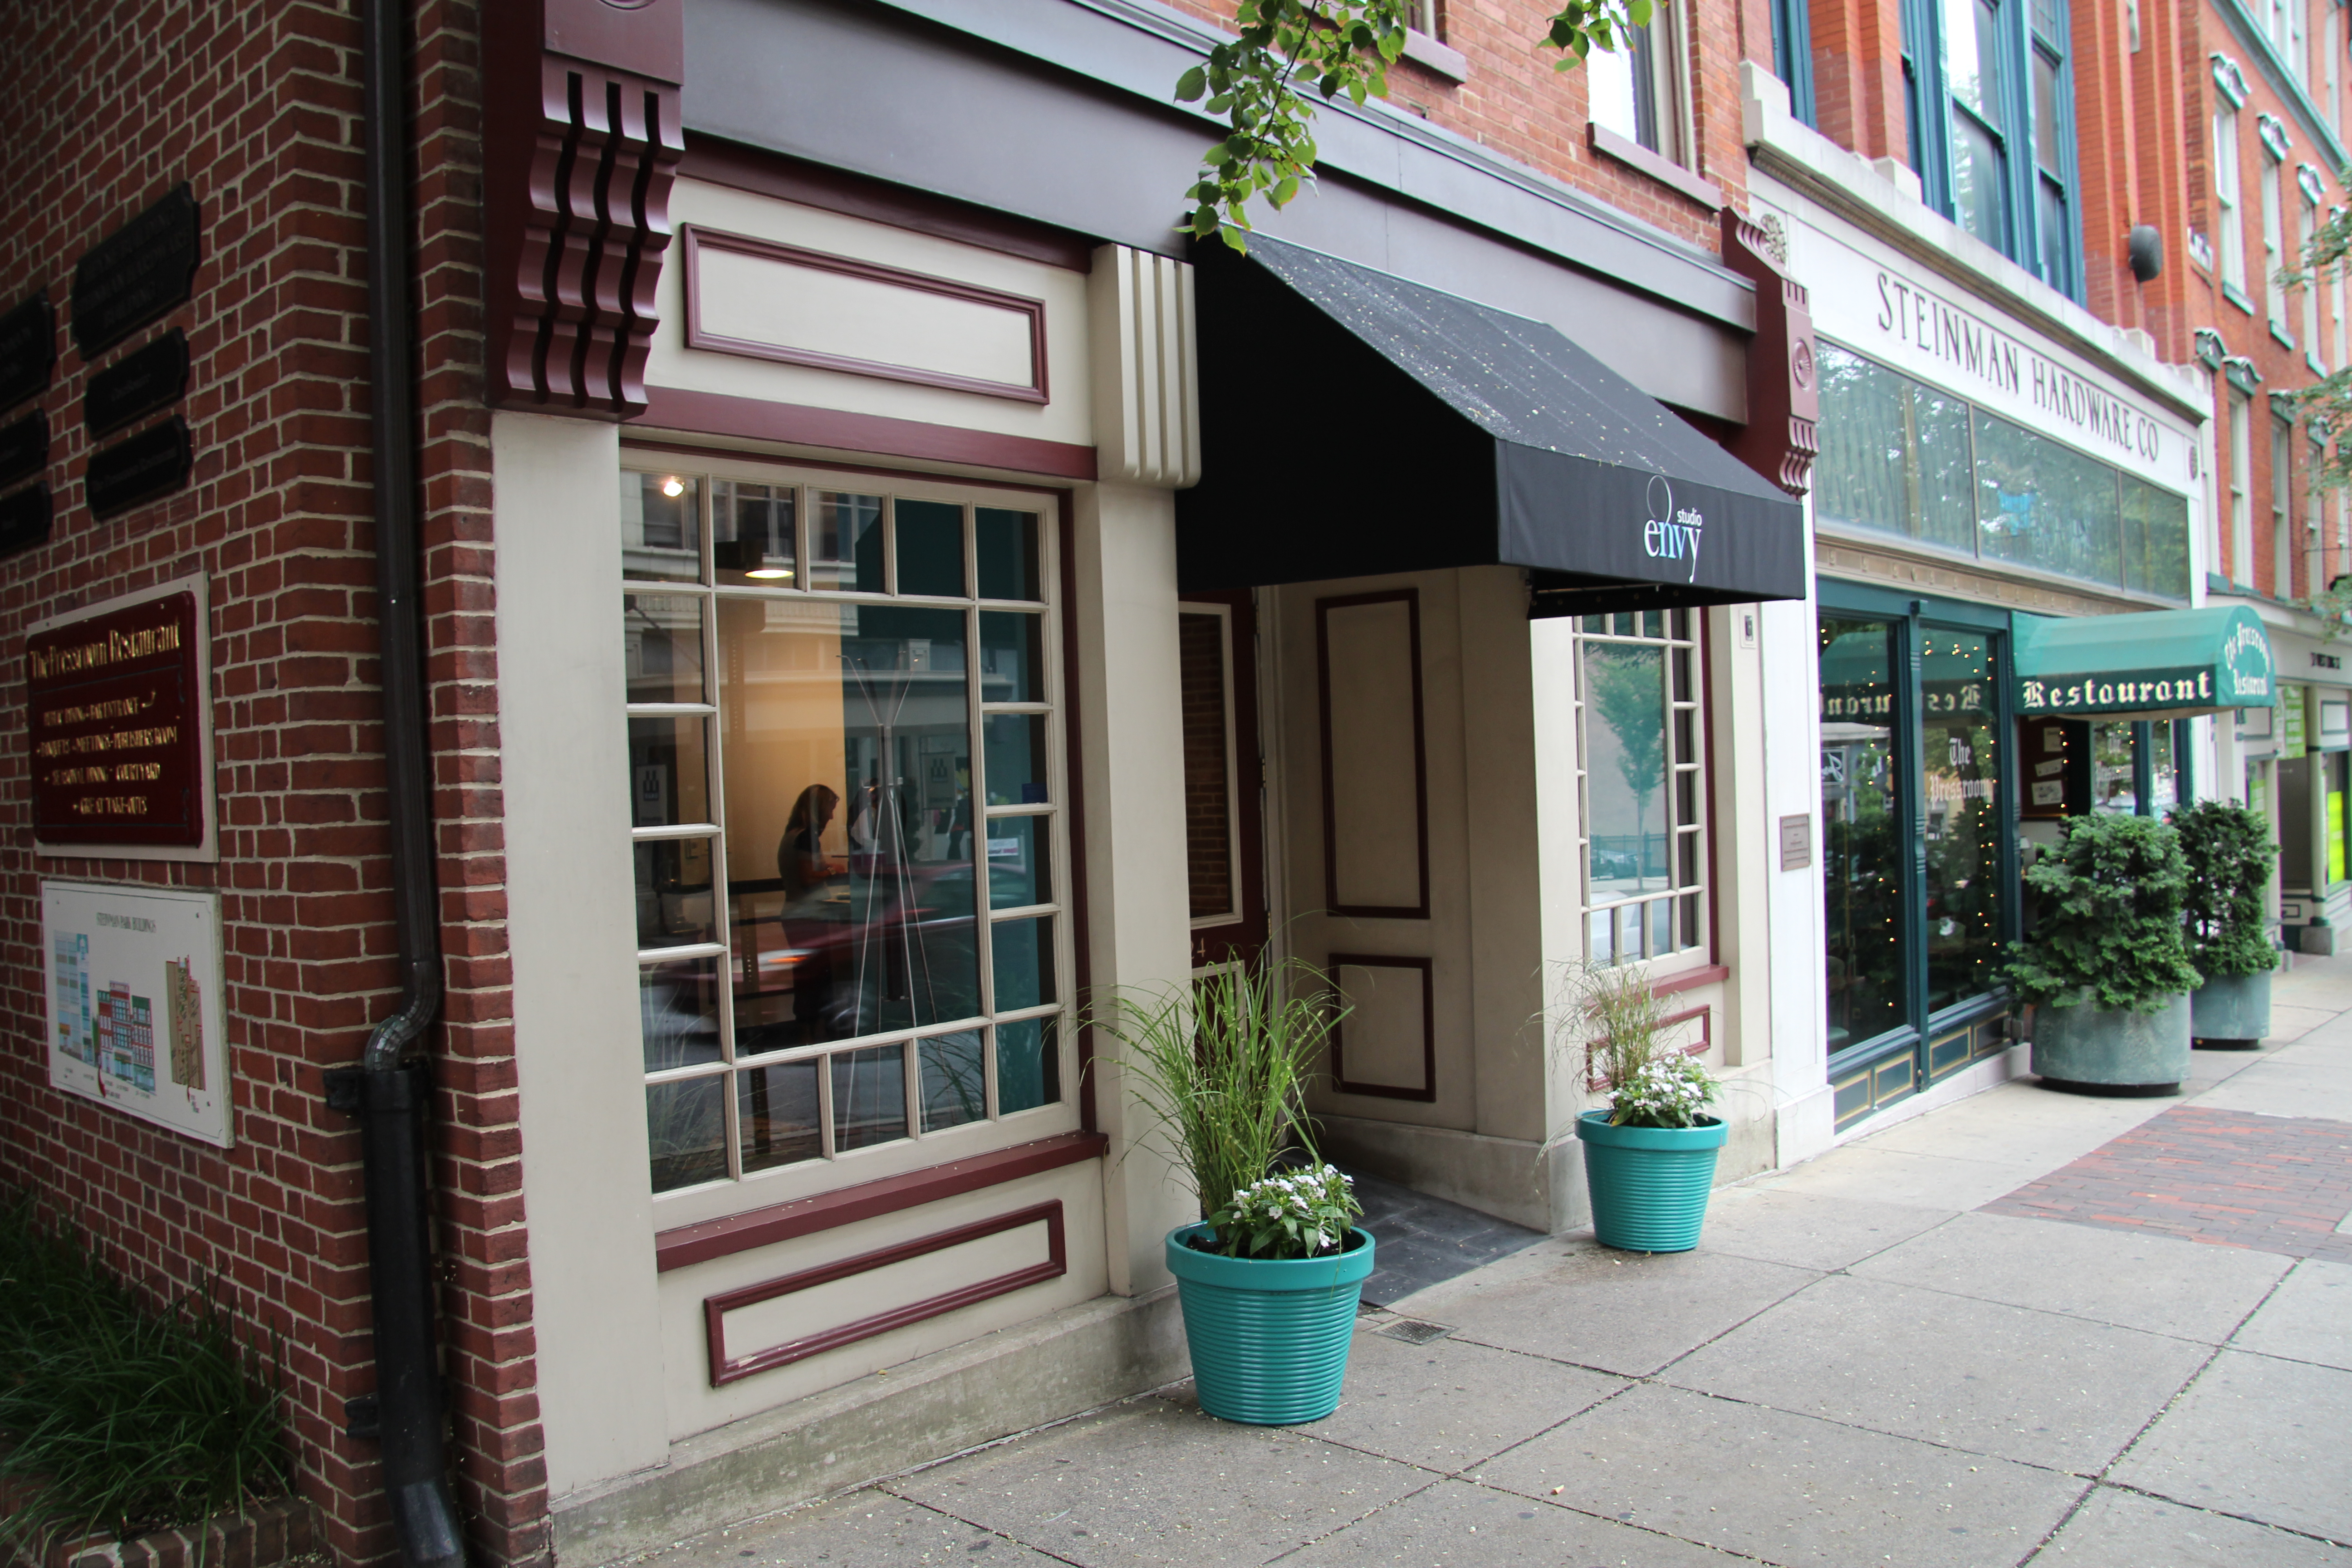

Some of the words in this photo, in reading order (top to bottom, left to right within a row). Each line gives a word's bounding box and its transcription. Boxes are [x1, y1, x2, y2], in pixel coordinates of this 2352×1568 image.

[1878, 272, 2018, 395] STEINMAN
[2032, 357, 2132, 450] HARDWARE
[2137, 417, 2158, 462] CO
[1677, 507, 1702, 526] studio
[1643, 518, 1702, 584] envy
[49, 642, 108, 676] Pressroom
[110, 616, 180, 663] Restaurant
[2022, 671, 2212, 709] Restaurant
[1949, 737, 1970, 767] The
[1930, 775, 1994, 810] Pressroom
